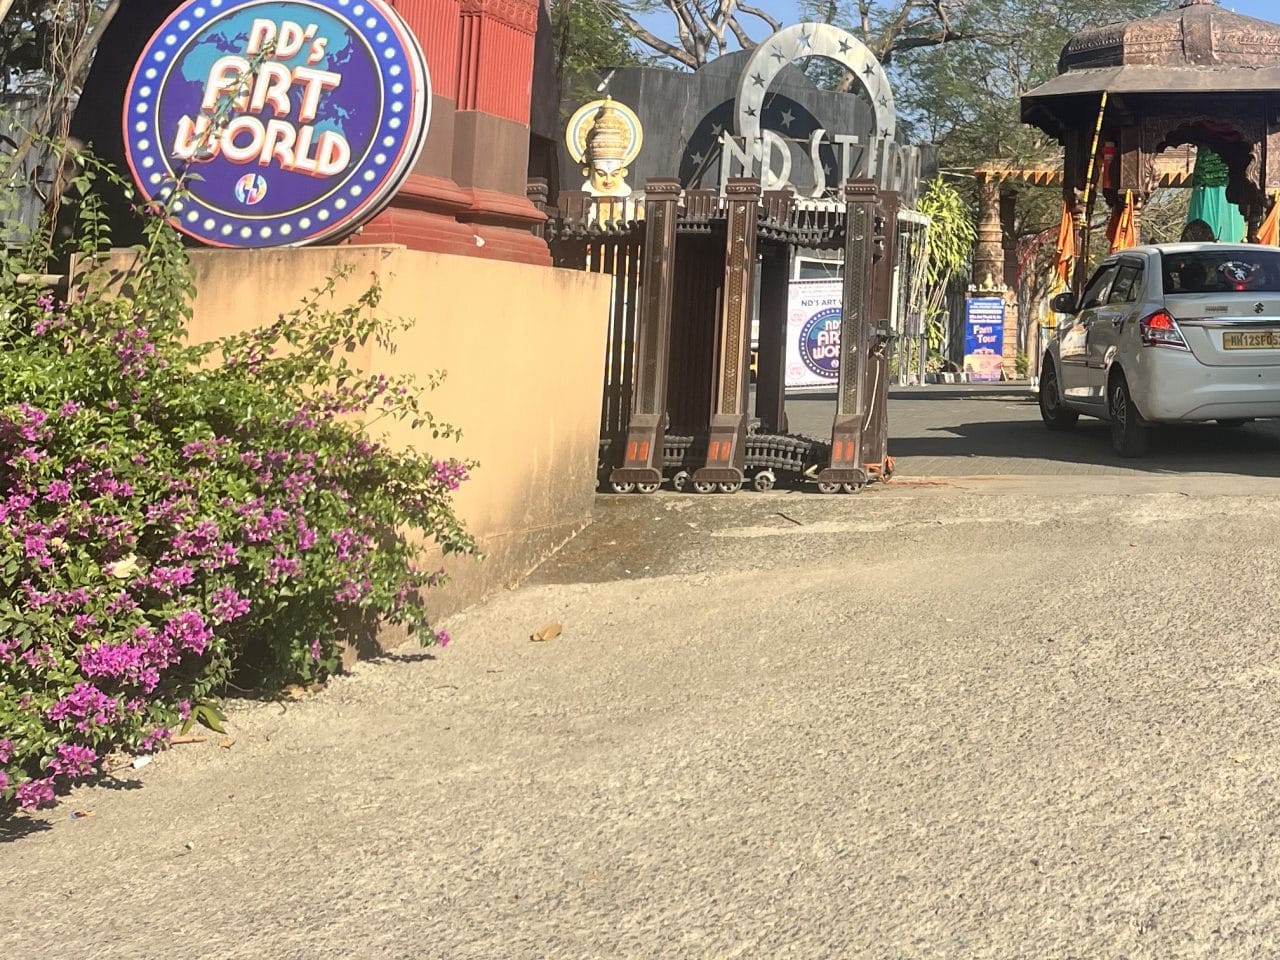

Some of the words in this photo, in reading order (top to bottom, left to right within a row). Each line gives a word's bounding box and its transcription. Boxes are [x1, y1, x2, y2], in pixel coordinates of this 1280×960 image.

[246, 18, 328, 64] ND's
[201, 55, 342, 123] ART
[171, 114, 352, 178] WORLD
[825, 320, 842, 331] ND'
[817, 331, 841, 346] AR
[977, 334, 997, 344] Tour
[812, 345, 841, 359] WOR
